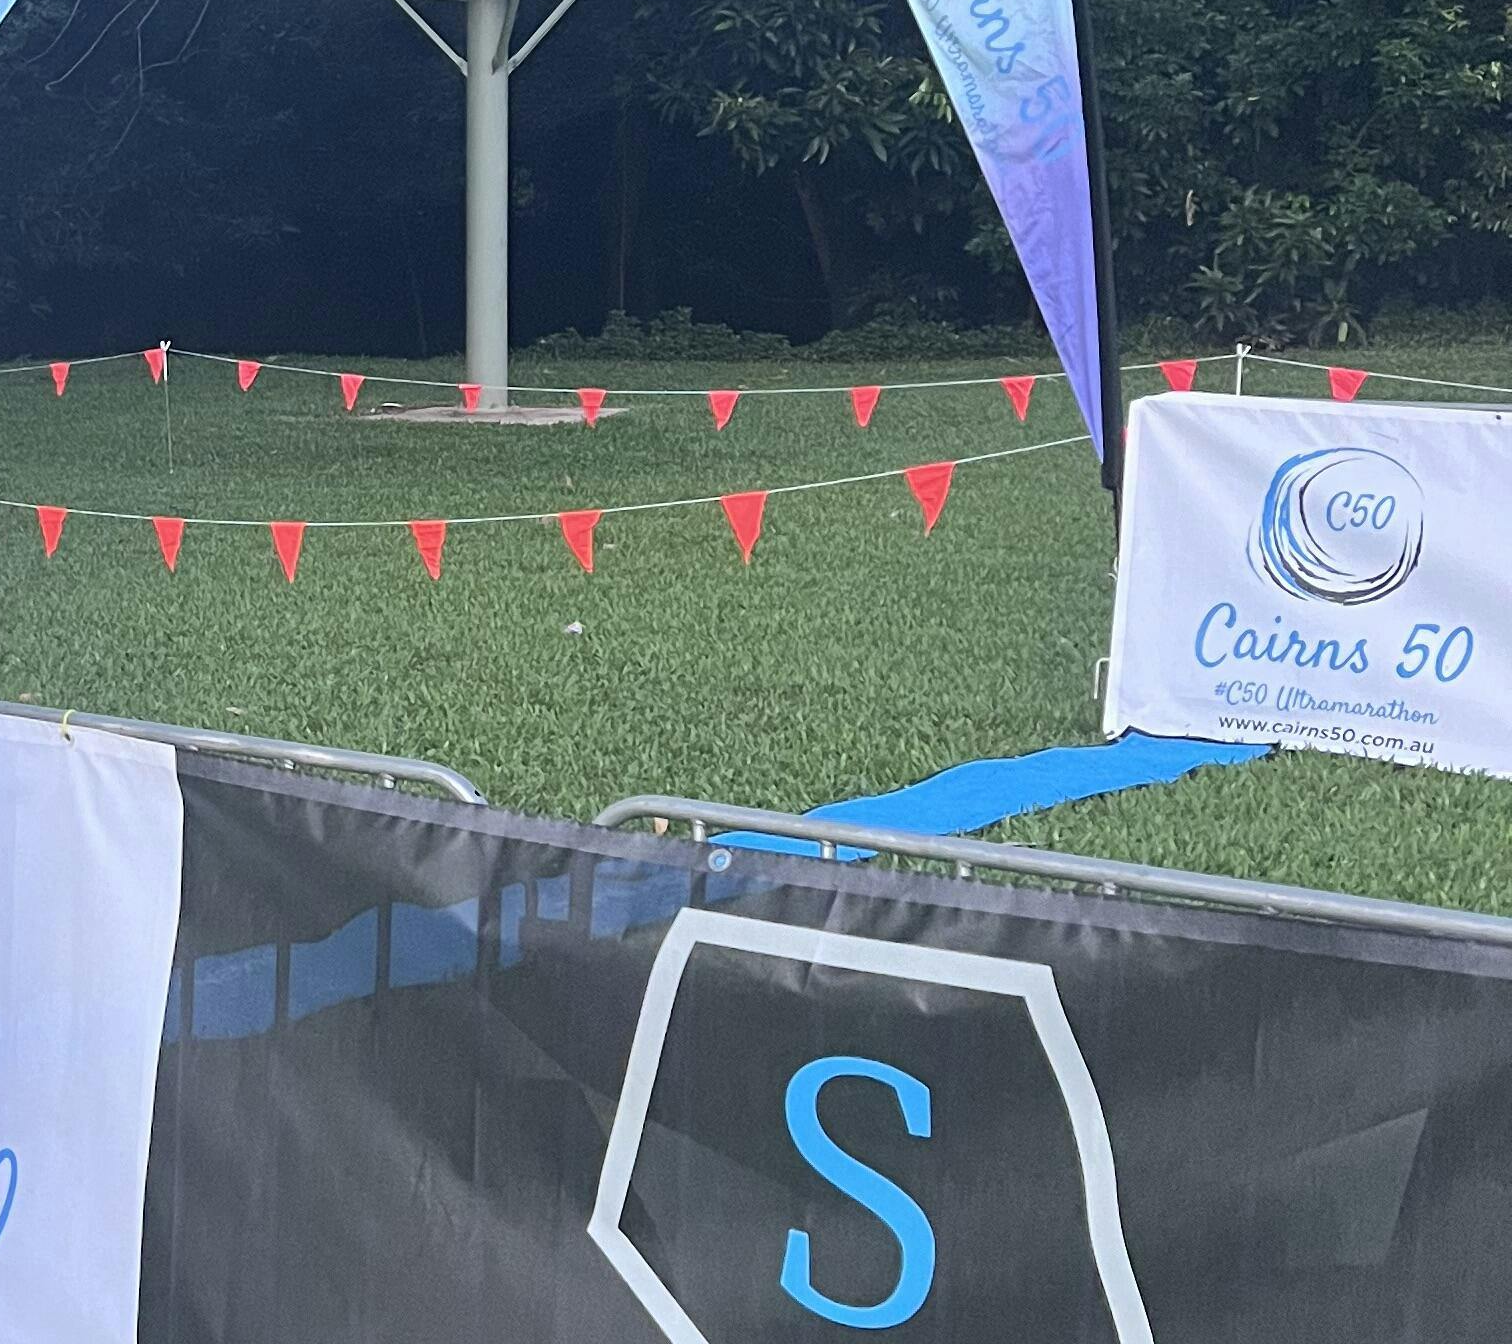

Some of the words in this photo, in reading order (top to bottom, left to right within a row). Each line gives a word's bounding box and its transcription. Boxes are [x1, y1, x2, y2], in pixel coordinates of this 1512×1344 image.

[1326, 491, 1397, 531] C50
[1194, 602, 1369, 674] Cairns
[1396, 623, 1474, 682] 50
[1214, 680, 1268, 707] #C50
[1276, 685, 1440, 725] Ultramarathon
[1218, 715, 1436, 754] www.cairns50.com.au
[780, 1056, 935, 1328] S
